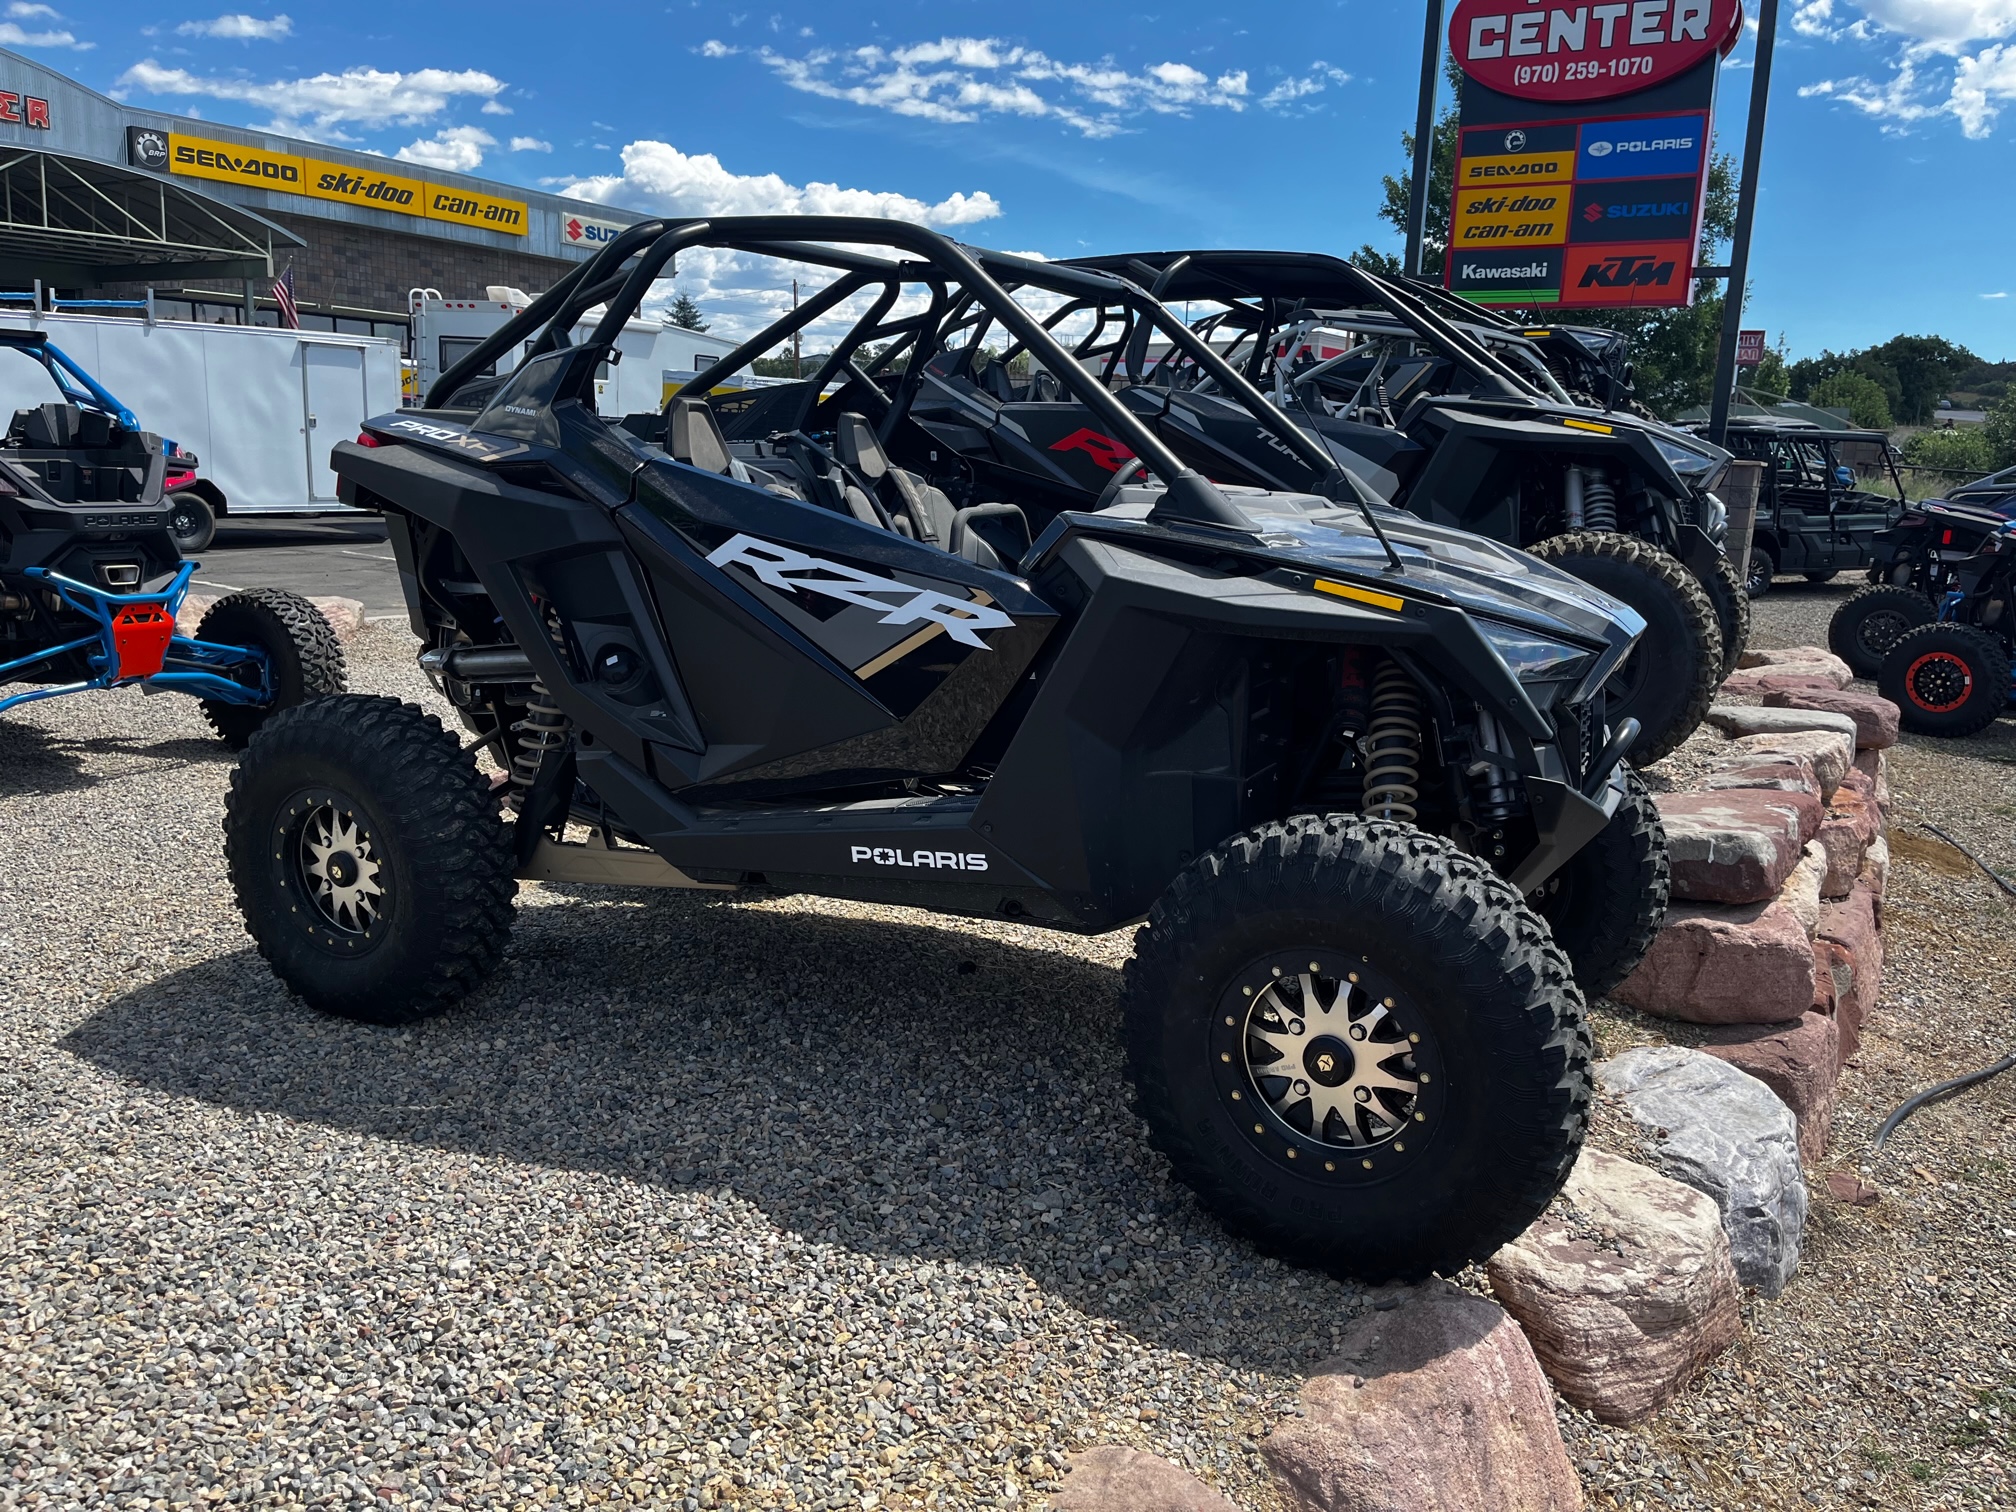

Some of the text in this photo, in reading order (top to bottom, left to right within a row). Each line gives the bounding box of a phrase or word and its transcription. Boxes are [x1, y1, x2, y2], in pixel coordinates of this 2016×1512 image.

[1467, 0, 1711, 60] CENTER
[1514, 56, 1654, 86] (970) 259-1070
[148, 149, 166, 158] BRP
[1616, 137, 1693, 153] POLARIS
[317, 173, 414, 205] ski-doo
[433, 193, 520, 225] can-am
[1466, 195, 1557, 214] ski-doo
[1607, 202, 1688, 219] SUZUKI
[585, 225, 622, 243] SUZ
[1463, 223, 1554, 239] can-am
[1462, 262, 1548, 279] Kawasaki
[1577, 256, 1676, 288] KTM
[390, 420, 460, 441] PRO
[1257, 427, 1314, 472] TUR
[84, 514, 158, 528] POLARIS
[705, 533, 1016, 650] RZR
[851, 846, 989, 872] POLARIS
